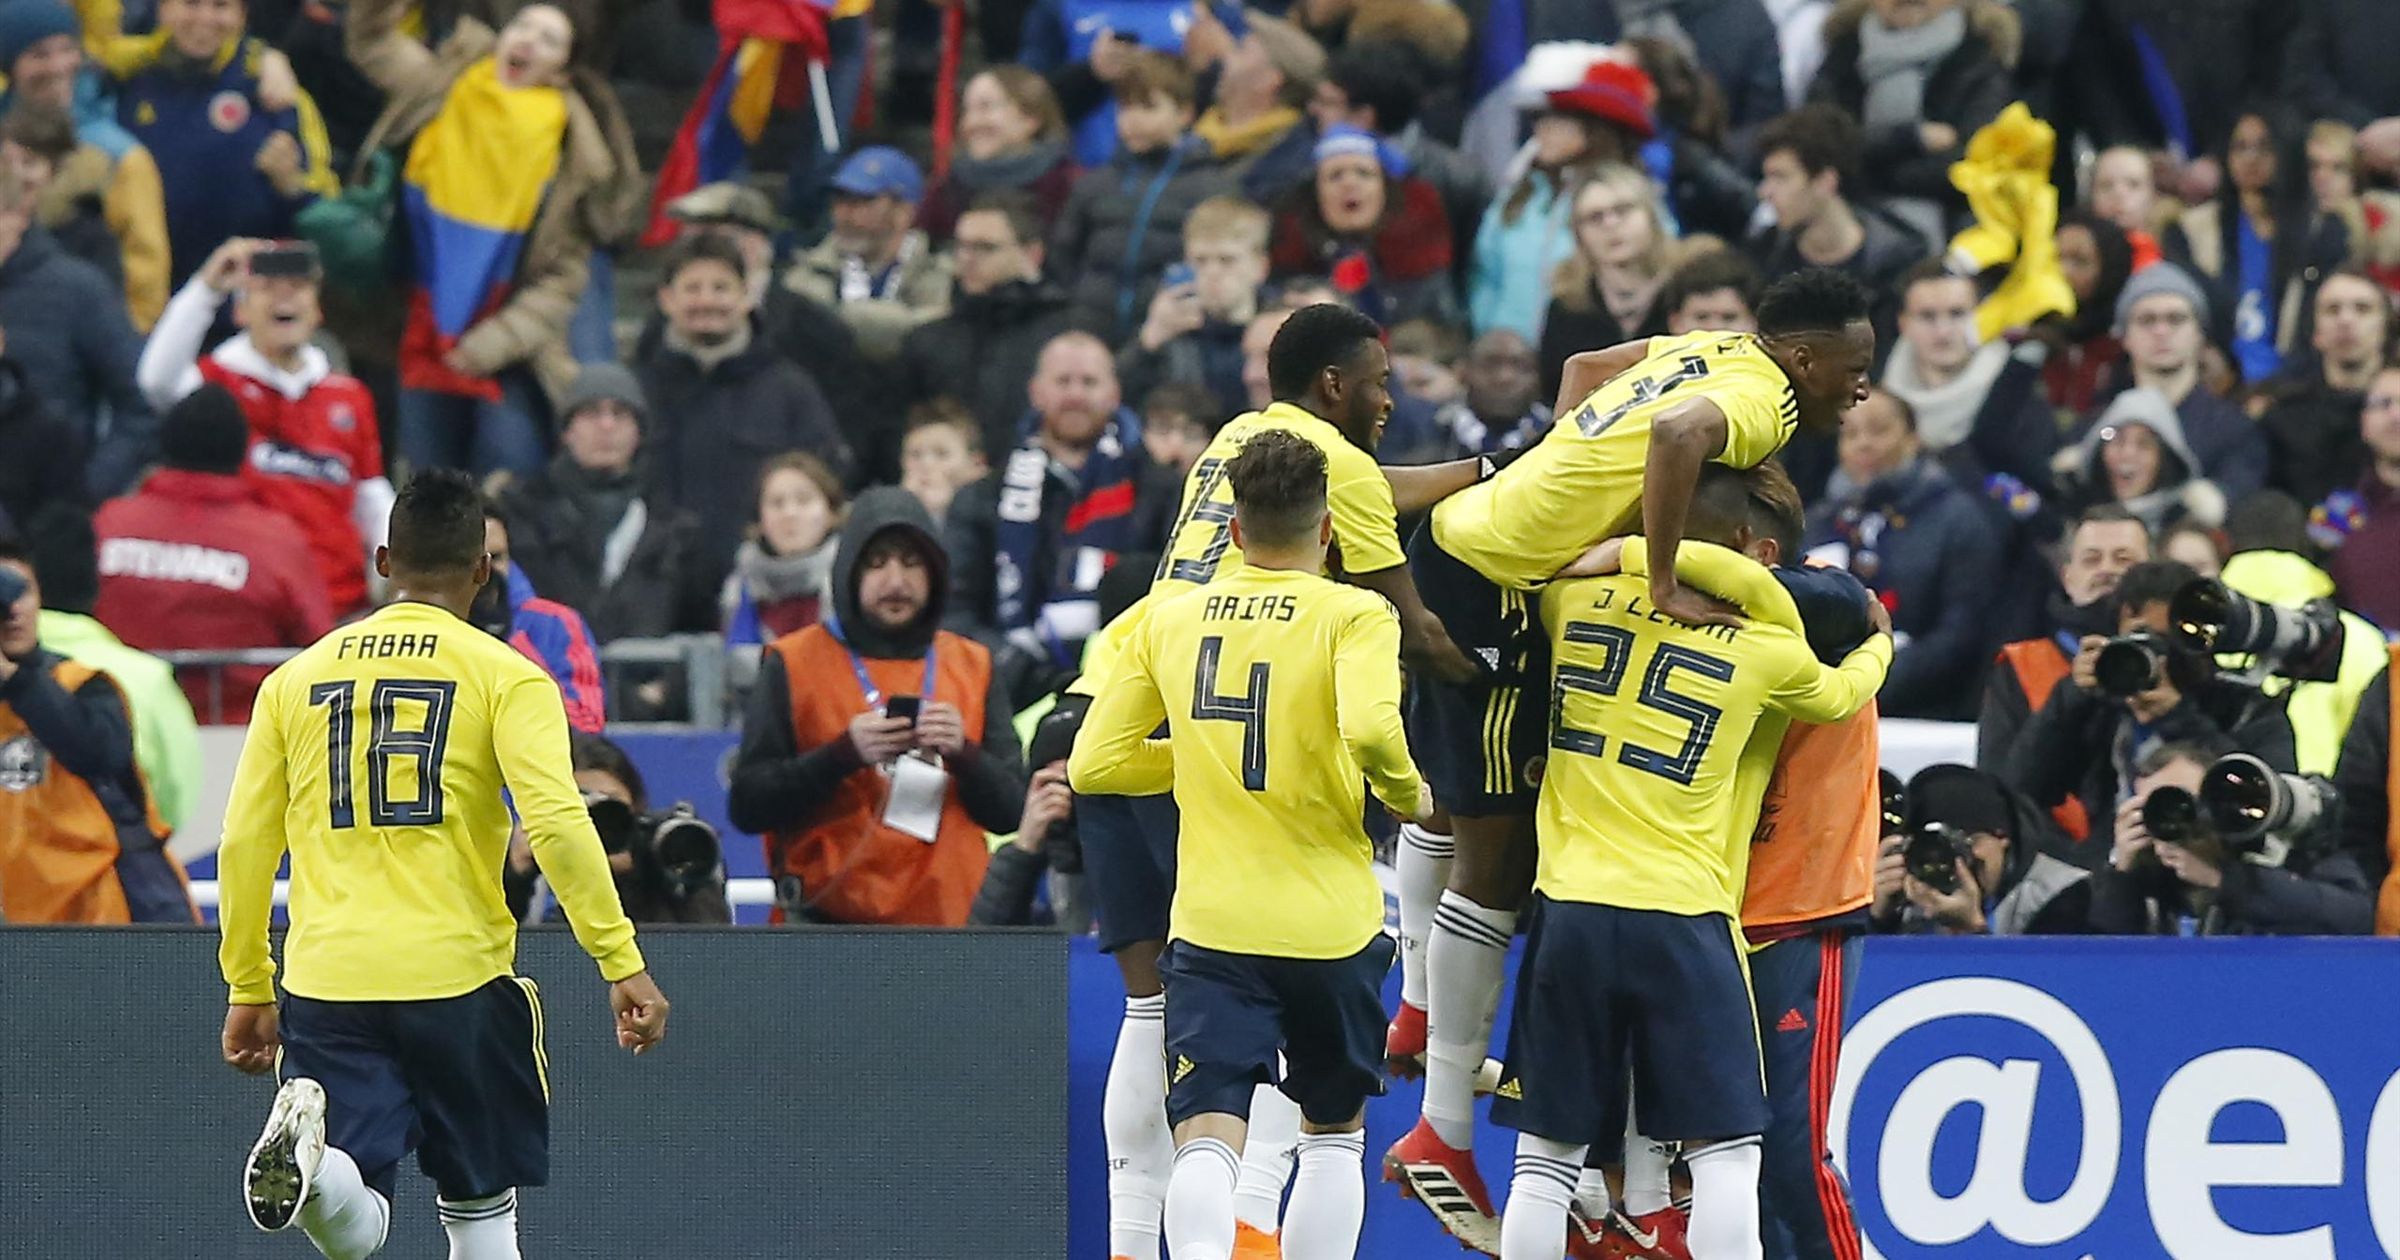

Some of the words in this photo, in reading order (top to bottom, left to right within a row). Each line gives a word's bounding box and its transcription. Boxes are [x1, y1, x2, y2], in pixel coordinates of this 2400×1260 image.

[337, 634, 438, 660] FABRA
[1202, 596, 1298, 622] ARIAS
[308, 679, 457, 829] 18
[1191, 636, 1271, 791] 4
[1551, 621, 1735, 786] 25
[1826, 975, 2400, 1260] @e
